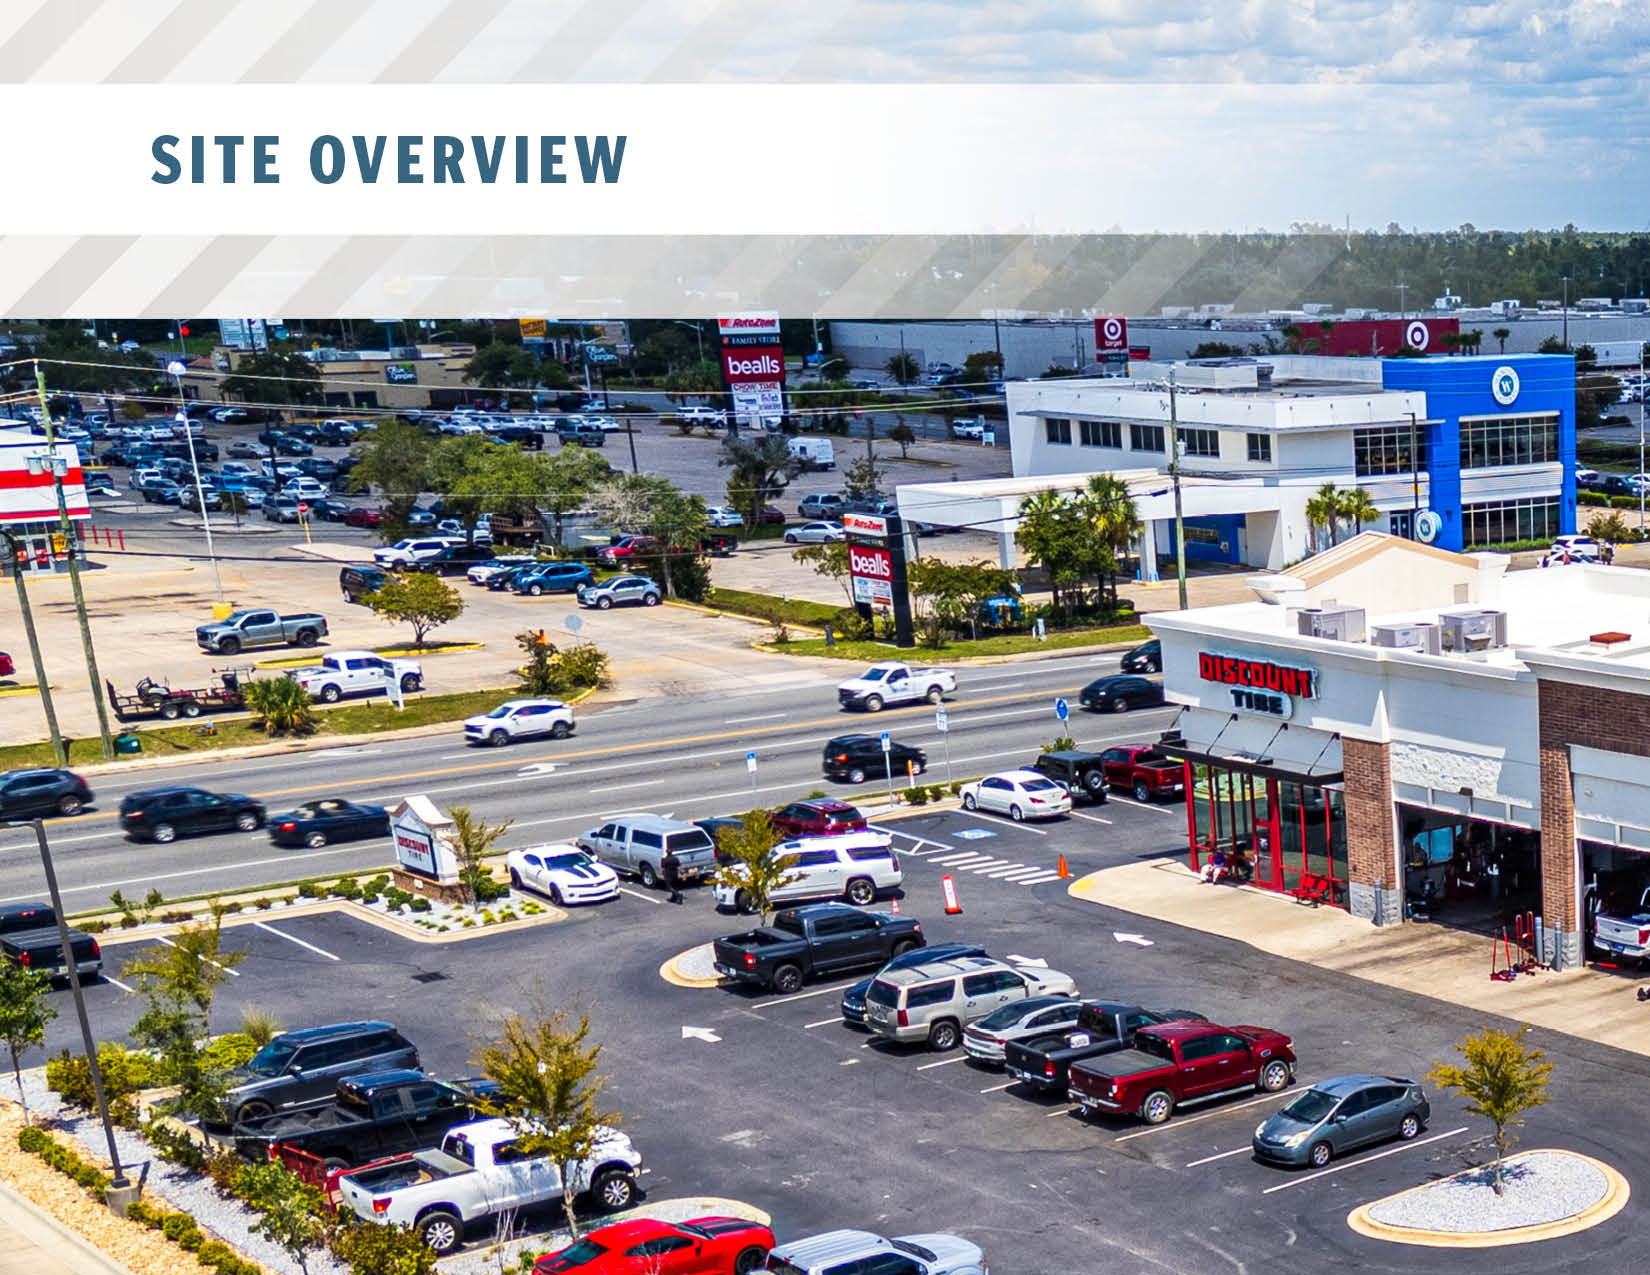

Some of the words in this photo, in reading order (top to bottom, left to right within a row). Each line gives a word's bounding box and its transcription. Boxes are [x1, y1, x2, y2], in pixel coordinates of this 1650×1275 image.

[728, 355, 780, 375] bealls
[850, 549, 890, 577] bealls
[1199, 652, 1312, 699] DISCOUNT
[1230, 689, 1284, 715] TIRE
